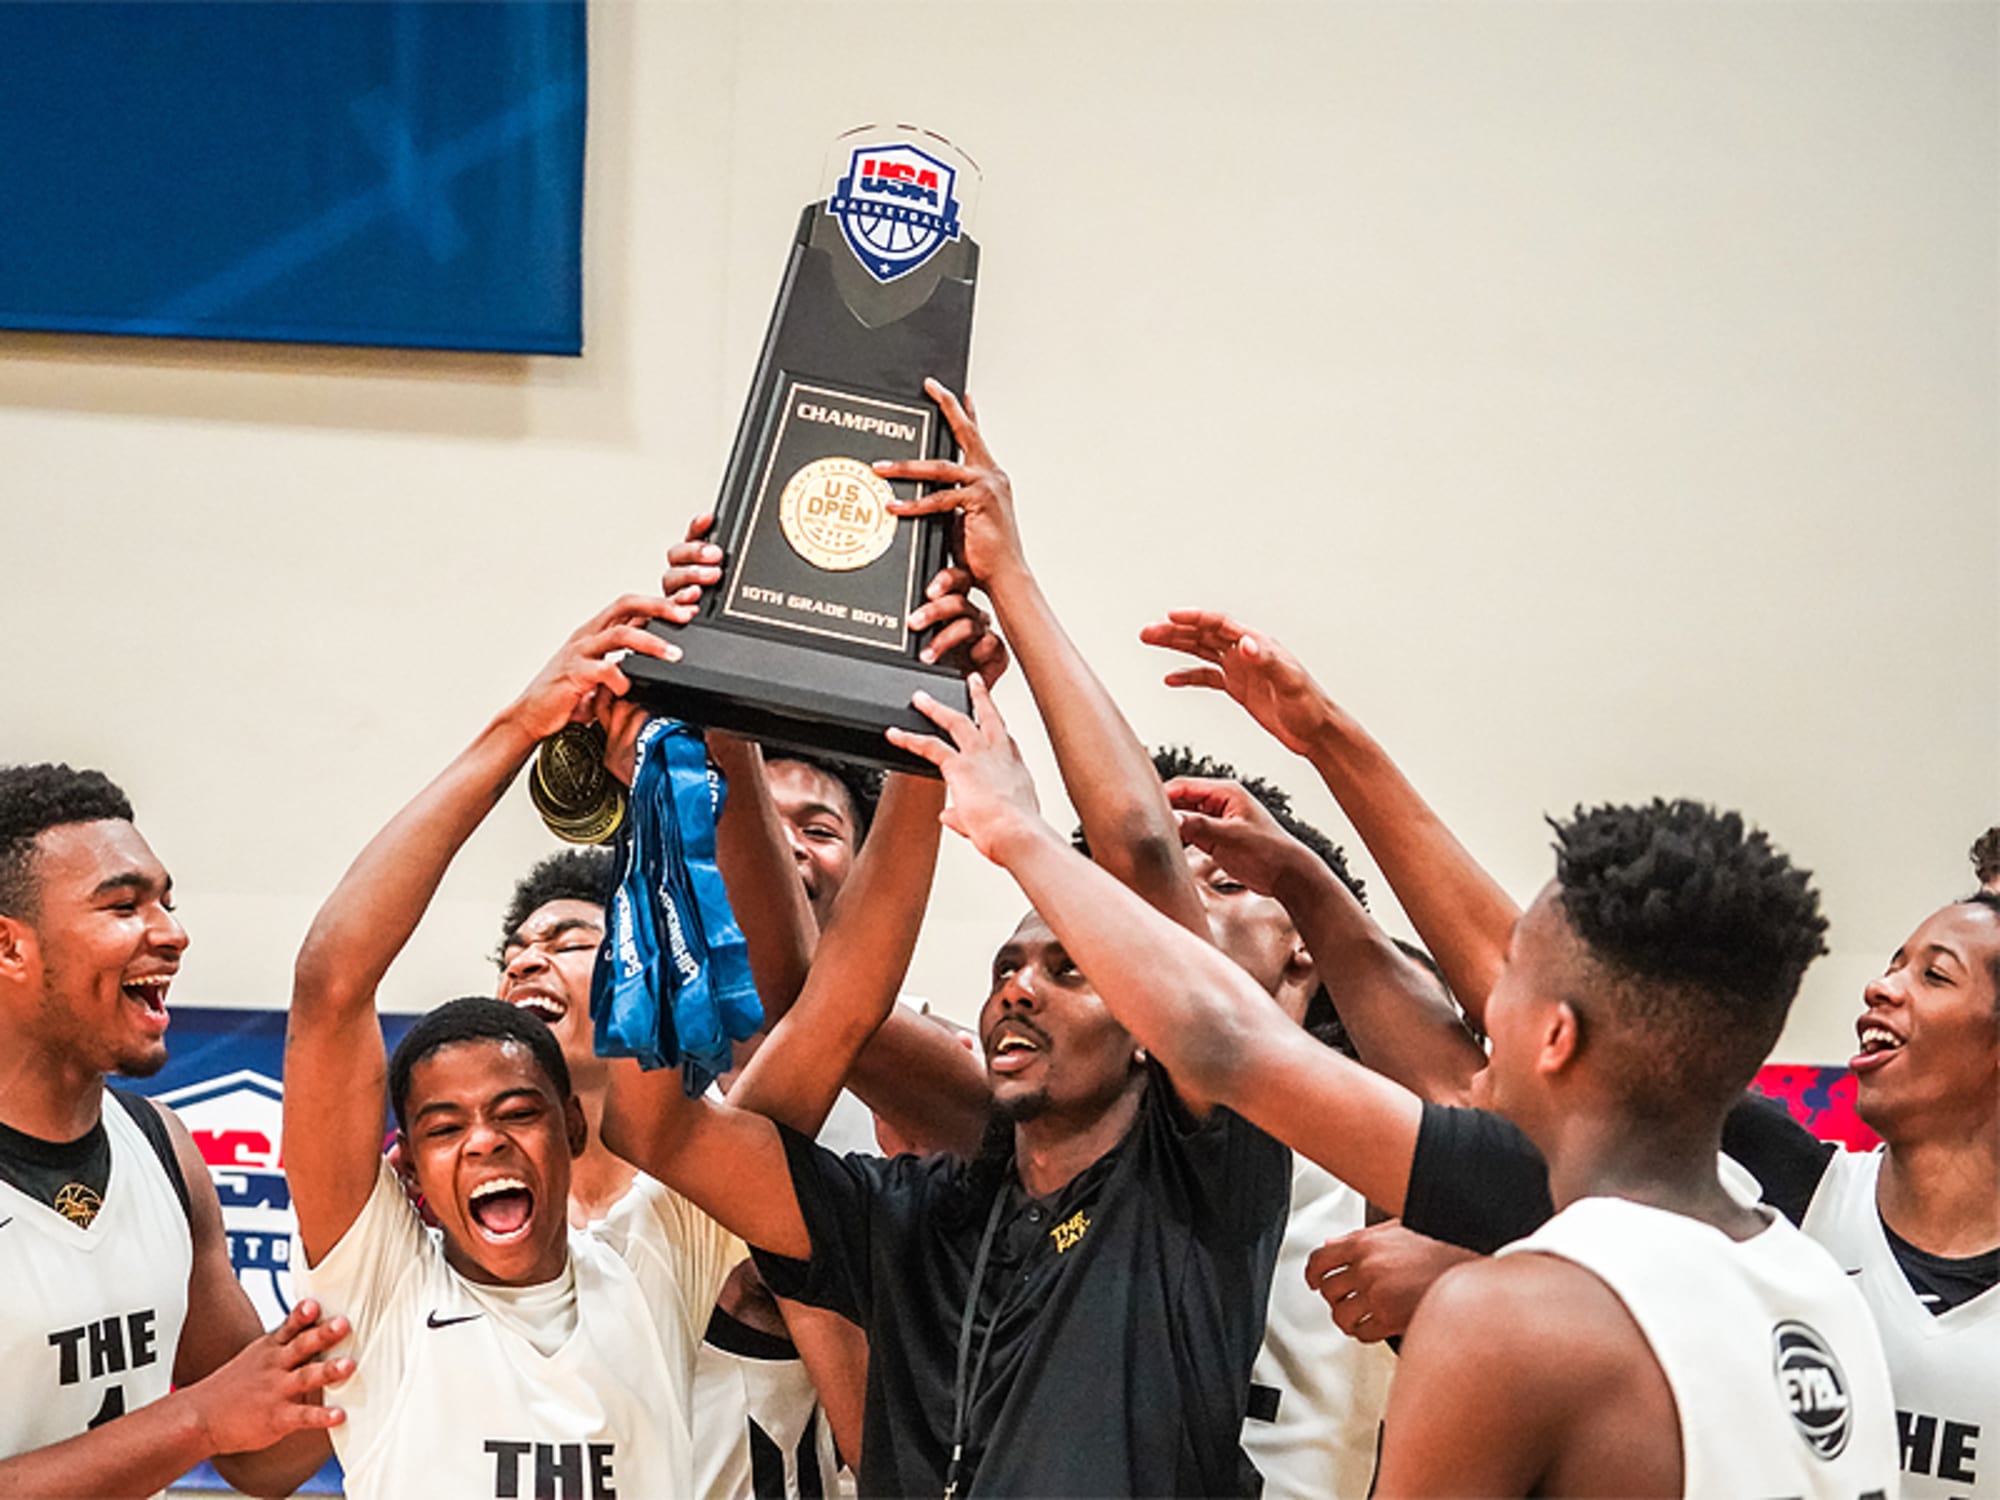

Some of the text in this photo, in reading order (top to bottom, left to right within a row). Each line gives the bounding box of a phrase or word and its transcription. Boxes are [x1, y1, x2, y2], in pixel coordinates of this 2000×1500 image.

[860, 159, 938, 208] USA
[797, 404, 916, 441] CHAMPION
[807, 496, 872, 526] OPEN
[742, 586, 899, 630] 10TH GRADE BOYS
[48, 1309, 157, 1385] THE
[484, 1440, 617, 1499] THE
[1896, 1409, 1980, 1484] HE
